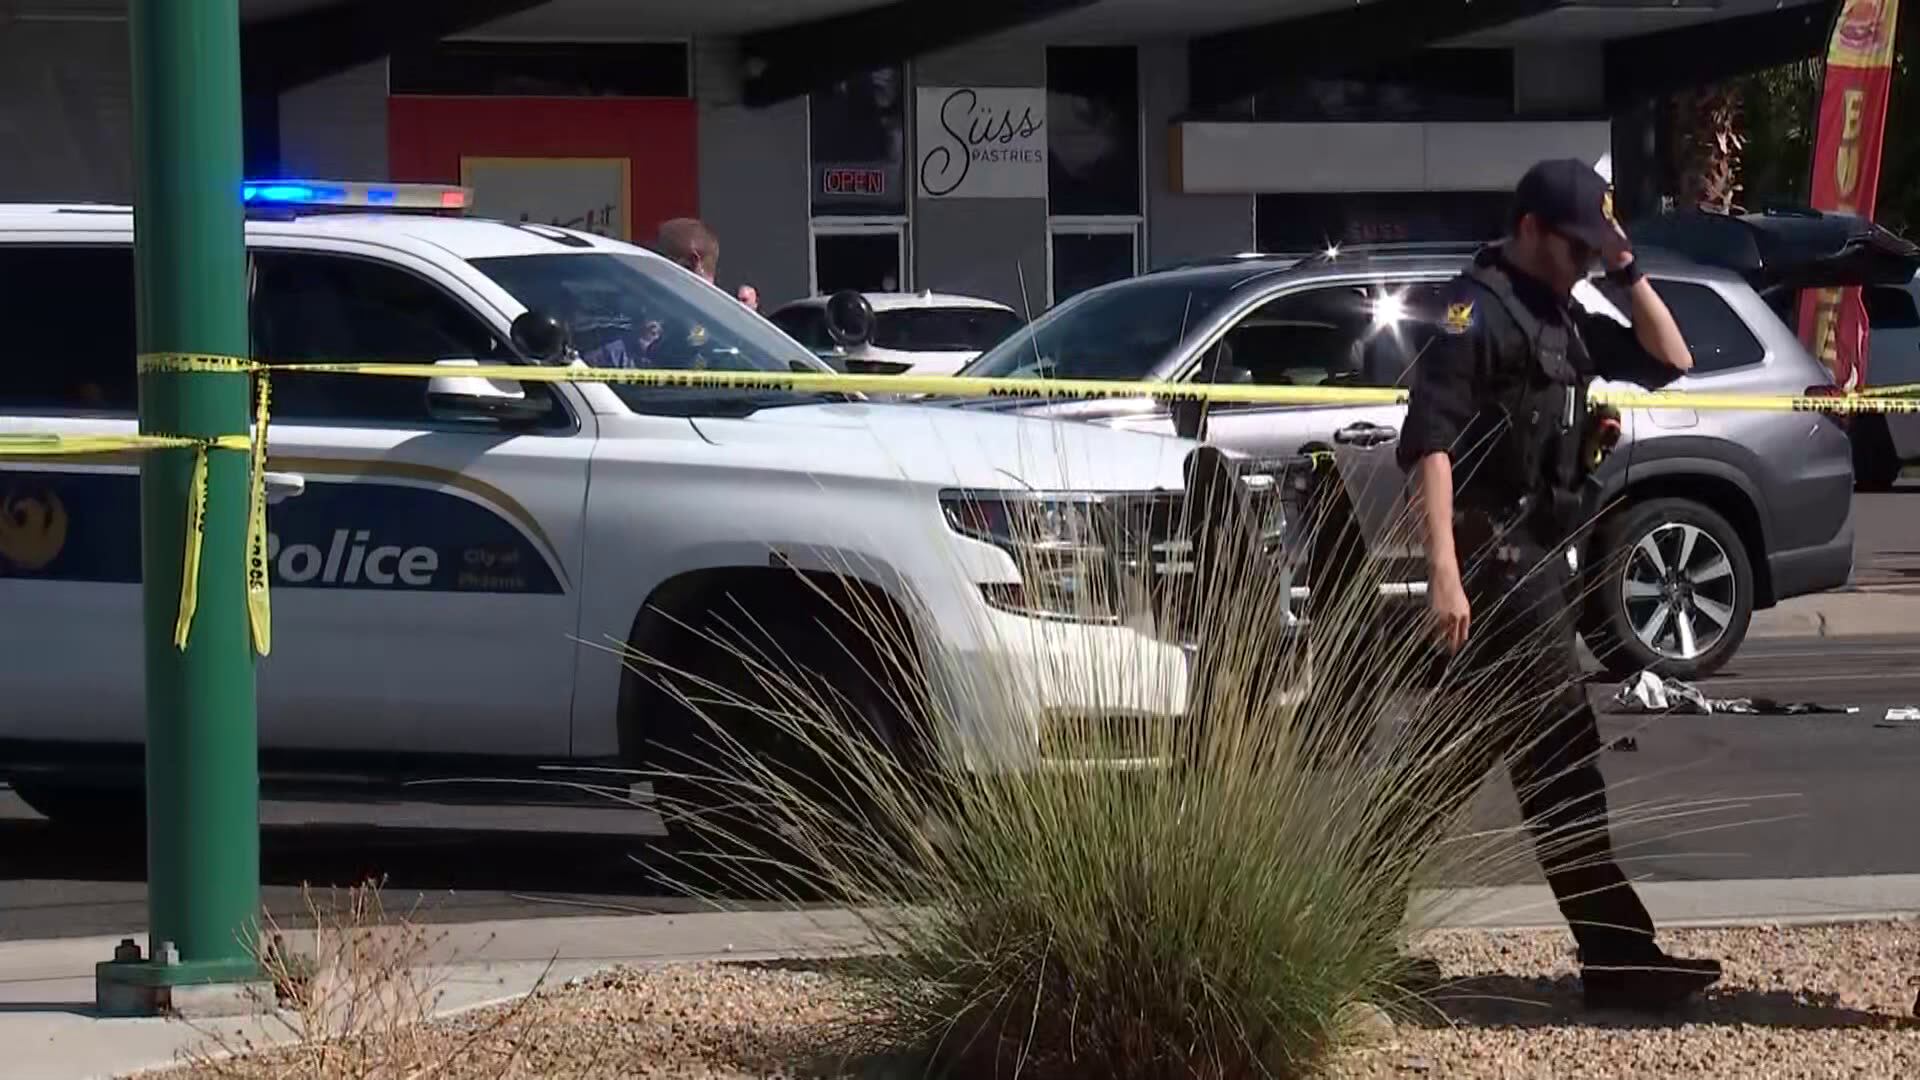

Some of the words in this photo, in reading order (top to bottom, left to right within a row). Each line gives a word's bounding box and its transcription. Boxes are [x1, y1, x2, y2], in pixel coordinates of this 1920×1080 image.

[920, 88, 1043, 196] Süss
[971, 149, 1043, 163] PASTRIES
[827, 171, 882, 193] OPEN
